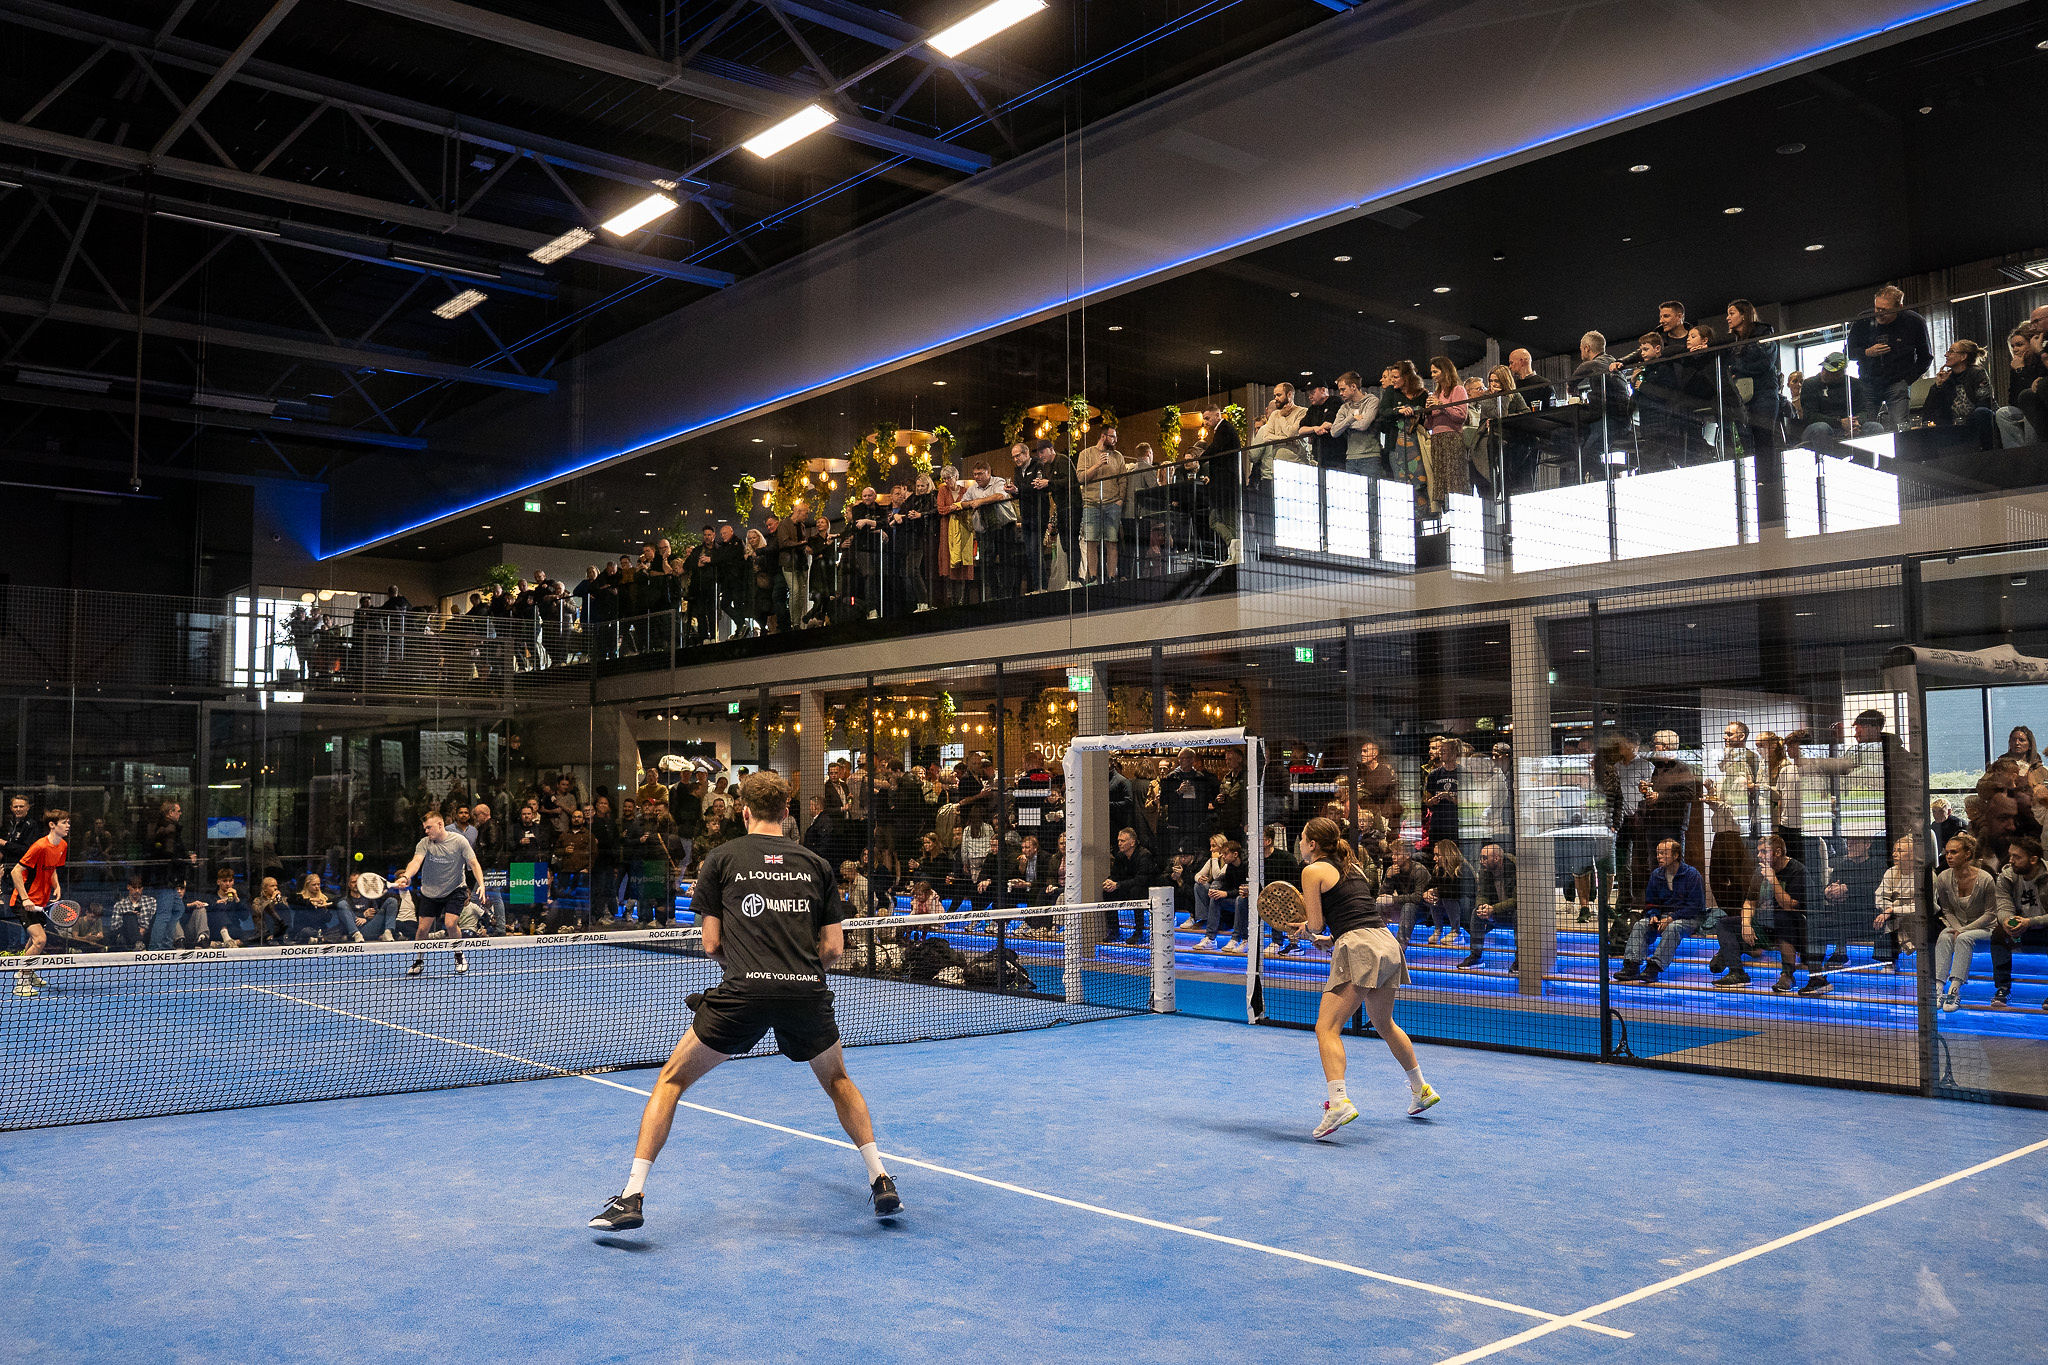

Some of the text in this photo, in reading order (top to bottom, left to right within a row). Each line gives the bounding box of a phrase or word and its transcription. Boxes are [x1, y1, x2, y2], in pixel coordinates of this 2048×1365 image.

[734, 870, 812, 882] A. LOUGHLAN
[765, 897, 811, 913] MANFLEX
[972, 911, 991, 919] PADEL
[849, 919, 875, 927] ROCKET
[536, 933, 609, 944] ROCKET PADEL
[649, 930, 680, 939] ROCKET
[413, 939, 492, 950] ROCKET PADEL
[134, 950, 228, 962] ROCKET PADEL
[280, 945, 365, 956] ROCKET PADEL
[0, 956, 77, 967] KET PADEL
[745, 972, 772, 980] MOVE
